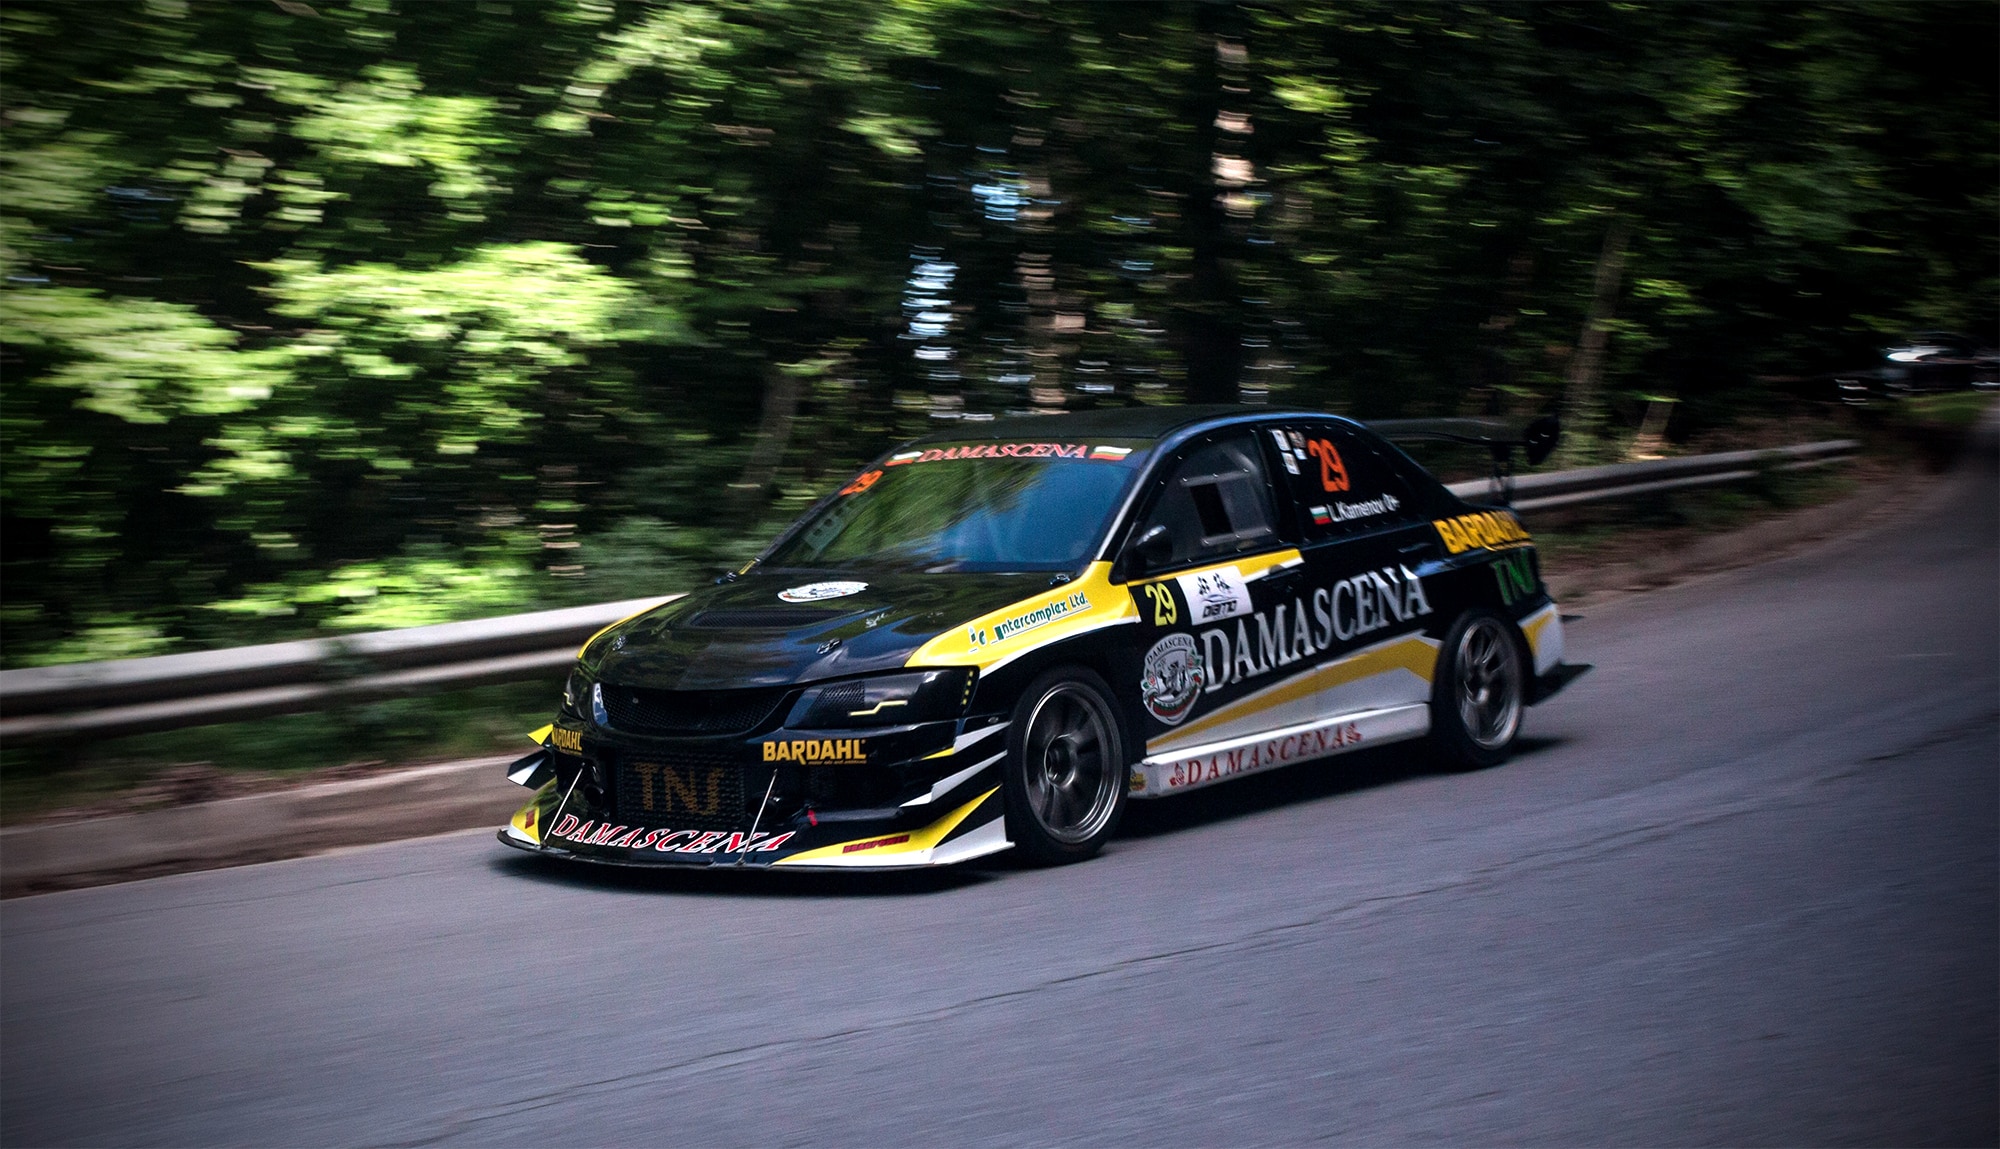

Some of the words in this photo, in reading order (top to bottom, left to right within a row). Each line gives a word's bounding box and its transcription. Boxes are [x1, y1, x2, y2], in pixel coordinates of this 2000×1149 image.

[916, 444, 1088, 462] DAMASCENA
[1307, 438, 1350, 492] 29
[1069, 592, 1088, 609] Ltd.
[1144, 583, 1177, 627] 29
[1200, 563, 1433, 693] DAMASCENA
[1146, 635, 1194, 665] DAMASCENA
[763, 739, 866, 765] BARDAHL
[1187, 722, 1347, 785] DAMASCENA
[552, 813, 796, 854] DAMASCENA
